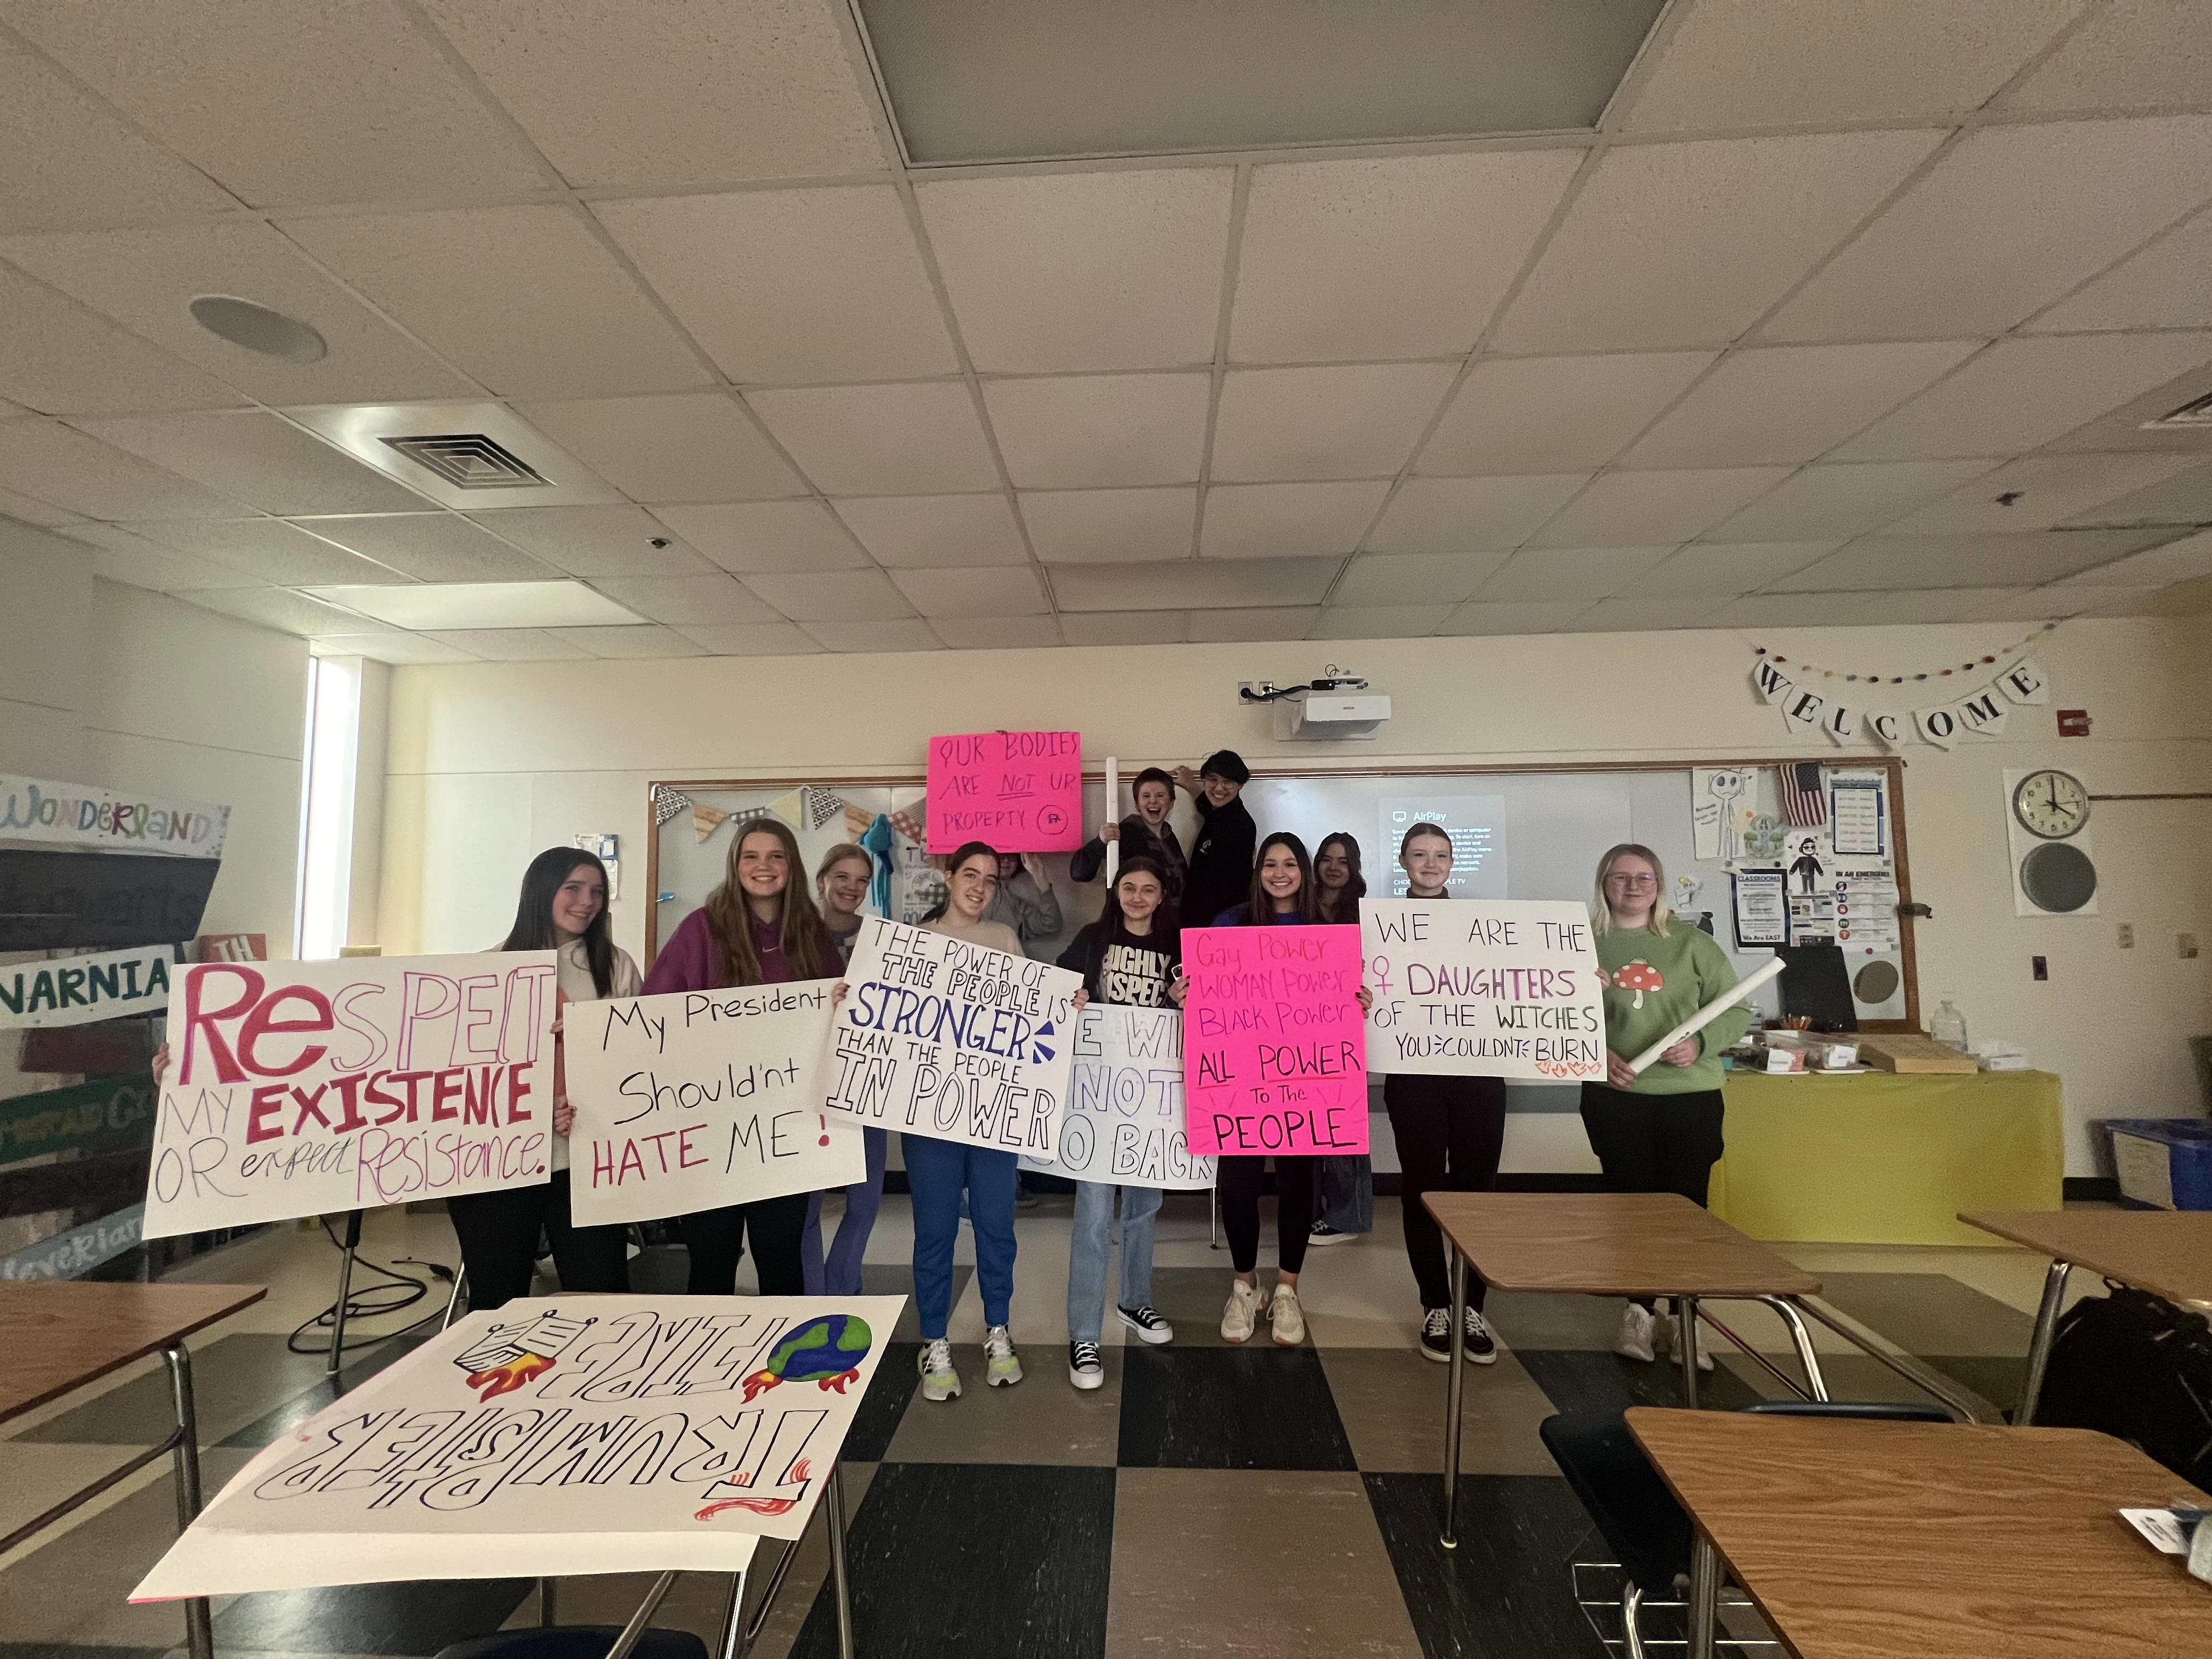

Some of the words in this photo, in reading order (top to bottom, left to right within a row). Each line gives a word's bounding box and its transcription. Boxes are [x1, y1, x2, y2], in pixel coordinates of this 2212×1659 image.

[1759, 663, 2041, 741] WELCOME
[1005, 731, 1077, 760] BODIES
[939, 774, 980, 799] ARE
[1001, 774, 1036, 793] NOT
[943, 809, 1025, 834] PROPERTY
[1413, 811, 1447, 822] AirPlay
[874, 919, 930, 956] THE
[944, 940, 1013, 981] POWER
[1022, 962, 1051, 989] OF
[1197, 933, 1242, 973] Gay
[1259, 933, 1334, 962] Power
[1375, 912, 1430, 943] WE
[1469, 919, 1518, 946] ARE
[1537, 922, 1586, 952] THE
[0, 958, 169, 1014] NARNIA
[882, 952, 938, 989] THE
[947, 968, 1040, 1016] PEOPLE
[1048, 995, 1067, 1024] IS
[1407, 963, 1575, 1001] DAUGHTERS
[603, 1001, 664, 1054] My
[686, 988, 827, 1028] President
[848, 981, 1031, 1060] STRONGER
[1073, 1008, 1103, 1057] E
[1125, 1011, 1184, 1058] WI
[1374, 1001, 1406, 1028] OF
[1420, 1005, 1475, 1026] THE
[1496, 1005, 1598, 1032] WITCHES
[838, 1027, 893, 1056] THAN
[907, 1042, 941, 1065] THE
[955, 1052, 1022, 1084] PEOPLE
[1199, 1050, 1235, 1086] ALL
[1258, 1041, 1361, 1080] POWER
[1396, 1033, 1431, 1060] YOU
[1536, 1036, 1598, 1062] BURN
[160, 1088, 233, 1143] MY
[246, 1062, 533, 1144] EXISTENCE
[613, 1057, 799, 1125] Should'nt
[826, 1048, 897, 1118] IN
[906, 1064, 1056, 1150] POWER
[1072, 1063, 1184, 1118] NOT
[1250, 1087, 1270, 1104] To
[1277, 1085, 1307, 1104] The
[592, 1124, 709, 1188] HATE
[1213, 1108, 1358, 1150] PEOPLE
[156, 1137, 249, 1203] OR
[241, 1136, 357, 1180] expect
[357, 1128, 545, 1204] Resistance.
[536, 1311, 789, 1402] FIRE
